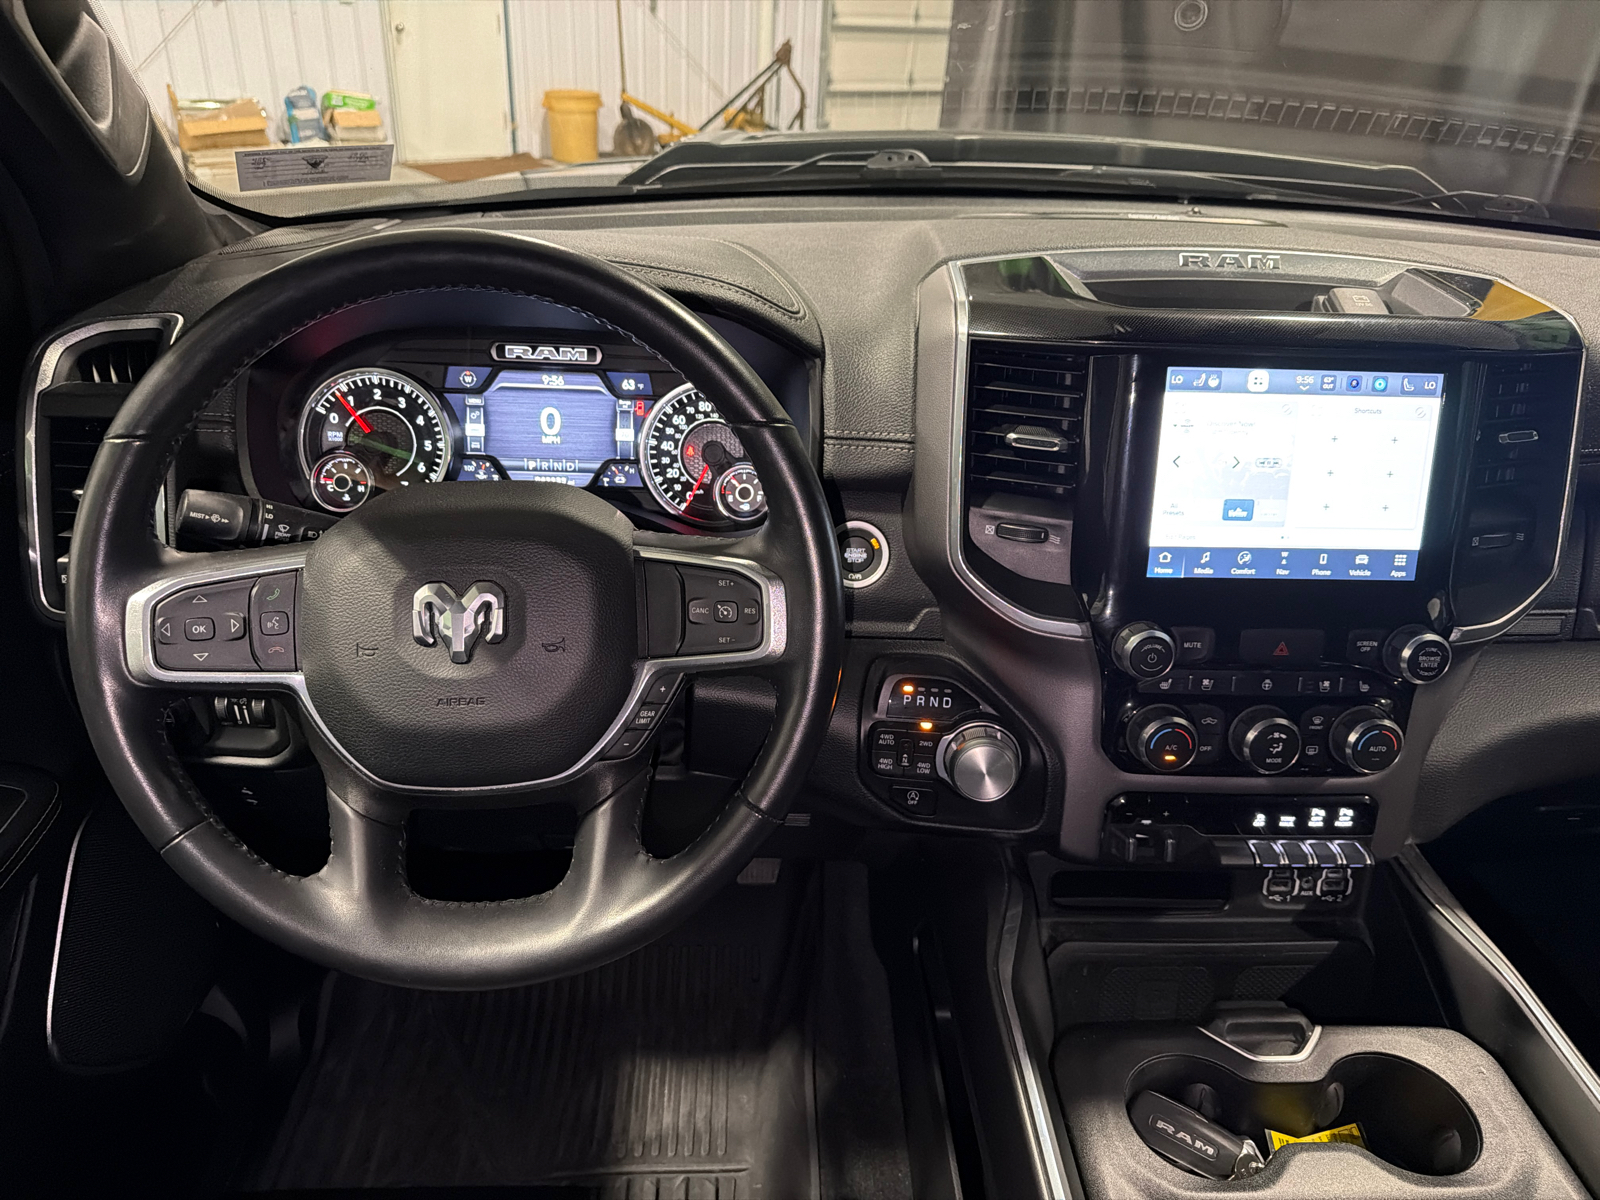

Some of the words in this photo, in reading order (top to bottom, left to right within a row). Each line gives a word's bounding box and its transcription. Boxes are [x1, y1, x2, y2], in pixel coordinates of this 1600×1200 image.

[1178, 252, 1281, 270] RAM
[504, 345, 587, 361] RAM
[542, 374, 564, 386] 9:56
[1171, 375, 1183, 384] LO
[1296, 375, 1315, 384] 9:56
[1424, 381, 1436, 389] LO
[373, 389, 382, 400] 2
[347, 396, 354, 406] 1
[398, 397, 407, 408] 3
[686, 406, 695, 414] 70
[698, 401, 712, 412] 80
[329, 413, 339, 424] 0
[416, 415, 425, 426] 4
[540, 406, 562, 436] 0
[672, 415, 686, 425] 60
[665, 427, 674, 435] 50
[542, 435, 560, 444] MPH
[424, 440, 432, 451] 5
[660, 441, 674, 451] 40
[417, 462, 426, 473] 6
[666, 468, 679, 478] 20
[674, 483, 681, 491] 10
[189, 511, 205, 519] MIST
[1230, 567, 1256, 575] Comfort
[1311, 568, 1332, 576] Phone
[192, 625, 207, 634] OK
[436, 697, 486, 707] AIRBAG
[1155, 1119, 1217, 1156] RAM
